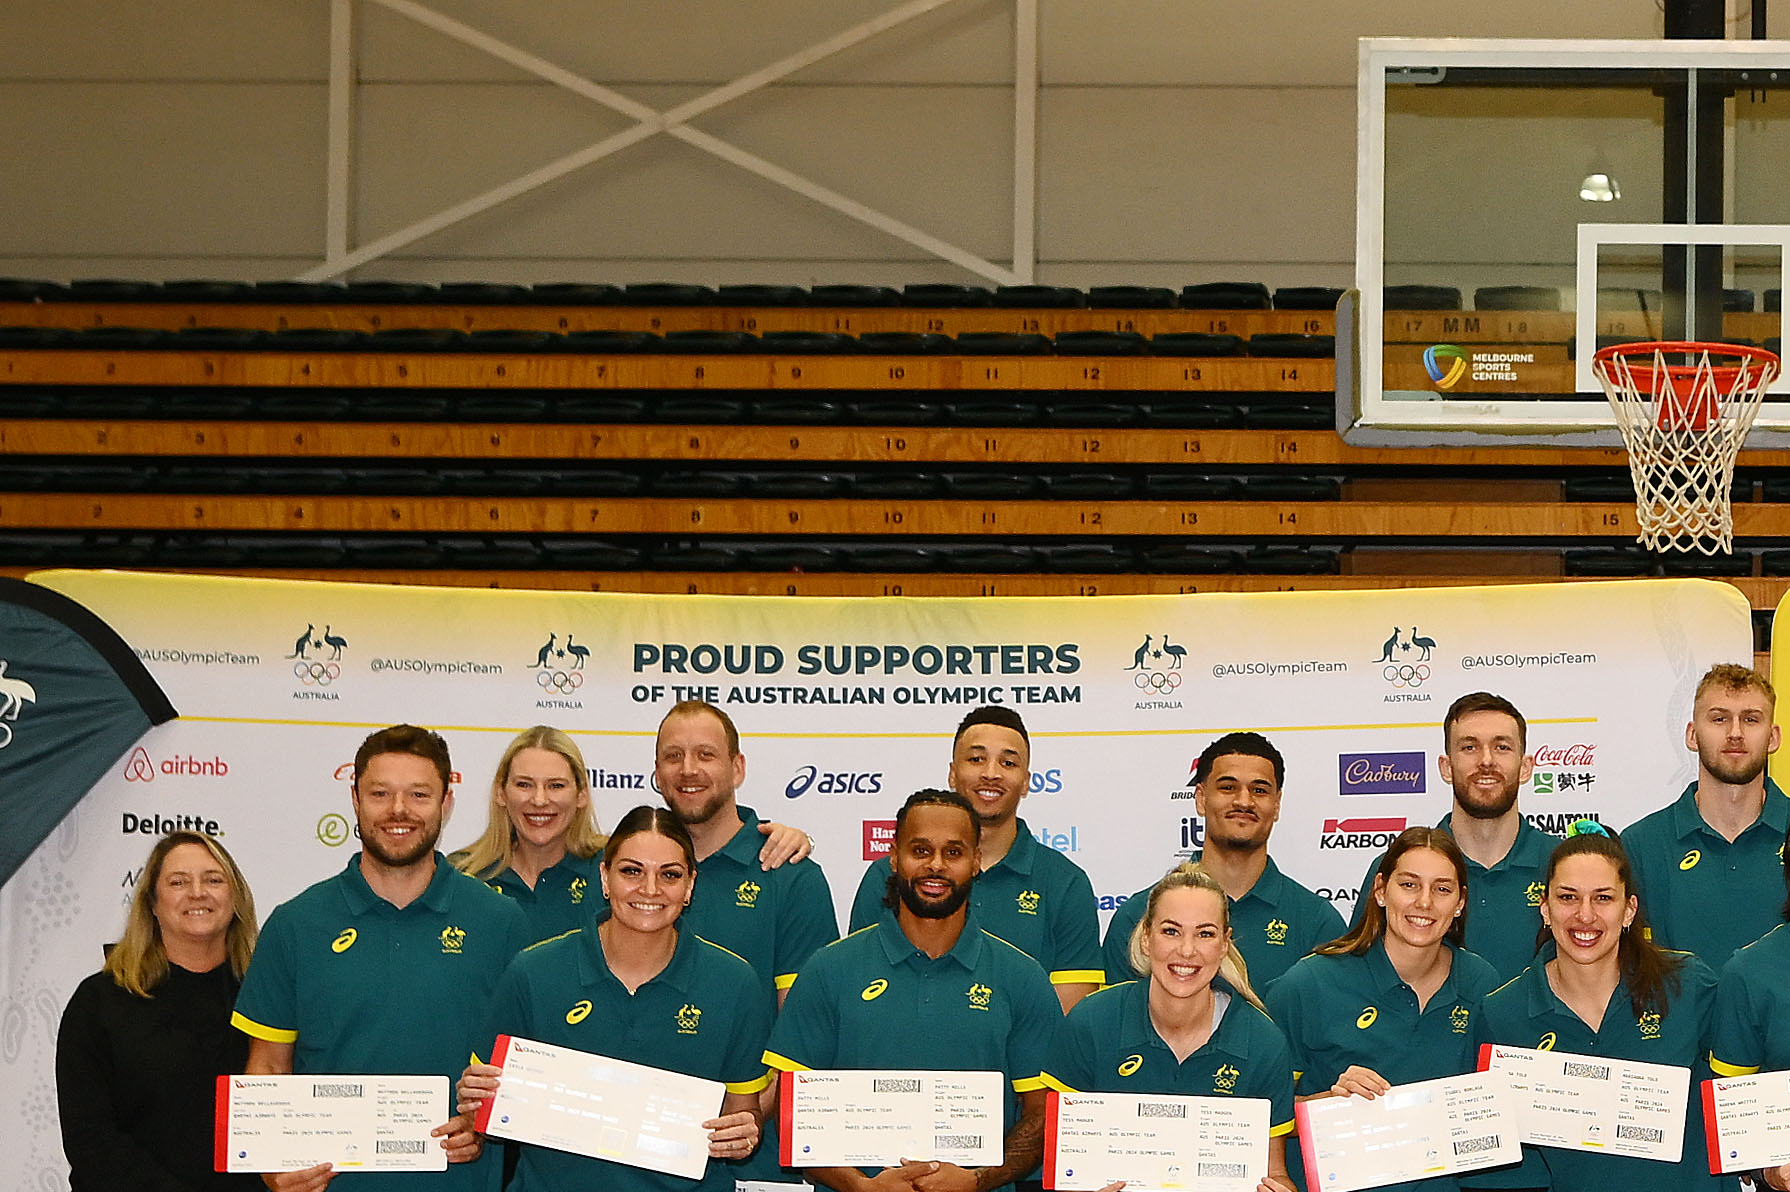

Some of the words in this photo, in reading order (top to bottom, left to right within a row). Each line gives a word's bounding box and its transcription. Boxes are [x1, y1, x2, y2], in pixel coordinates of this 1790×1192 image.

[1023, 320, 1039, 330] 13
[1210, 321, 1227, 333] 15
[1303, 321, 1321, 334] 16
[1471, 353, 1535, 365] MELBOURNE
[791, 367, 802, 379] 9
[889, 367, 905, 379] 10
[986, 367, 998, 380] 11
[1083, 367, 1100, 380] 12
[1184, 368, 1201, 381] 13
[1471, 363, 1512, 373] SPORTS
[1281, 369, 1298, 381] 14
[1471, 371, 1519, 382] CENTRES
[886, 438, 906, 451] 10
[985, 439, 997, 452] 11
[1083, 440, 1100, 453] 12
[1183, 440, 1201, 453] 13
[1280, 441, 1297, 454] 14
[788, 511, 799, 524] 9
[884, 512, 903, 524] 10
[982, 512, 996, 524] 11
[1080, 512, 1102, 525] 12
[1181, 512, 1198, 525] 13
[1279, 512, 1297, 525] 14
[1603, 513, 1619, 526] 15
[633, 643, 784, 675] PROUD
[797, 643, 1081, 676] SUPPORTERS
[1461, 652, 1596, 670] @AUSOlympicTeam
[370, 658, 503, 675] @AUSOlympicTeam
[1212, 661, 1348, 678] @AUSOlympicTeam
[292, 691, 340, 701] AUSTRALIA
[631, 685, 665, 703] OF
[671, 685, 720, 704] THE
[726, 686, 885, 705] AUSTRALIAN
[892, 686, 1004, 705] OLYMPIC
[1010, 685, 1081, 704] TEAM
[1383, 693, 1432, 703] AUSTRALIA
[535, 700, 583, 709] AUSTRALIA
[1134, 701, 1183, 710] AUSTRALIA
[160, 754, 229, 776] airbnb
[587, 769, 645, 789] llianz
[1345, 759, 1420, 787] Cadbury
[1557, 772, 1596, 793] 蒙牛
[1503, 1052, 1534, 1061] QANTAS
[1726, 1081, 1757, 1089] QANTAS
